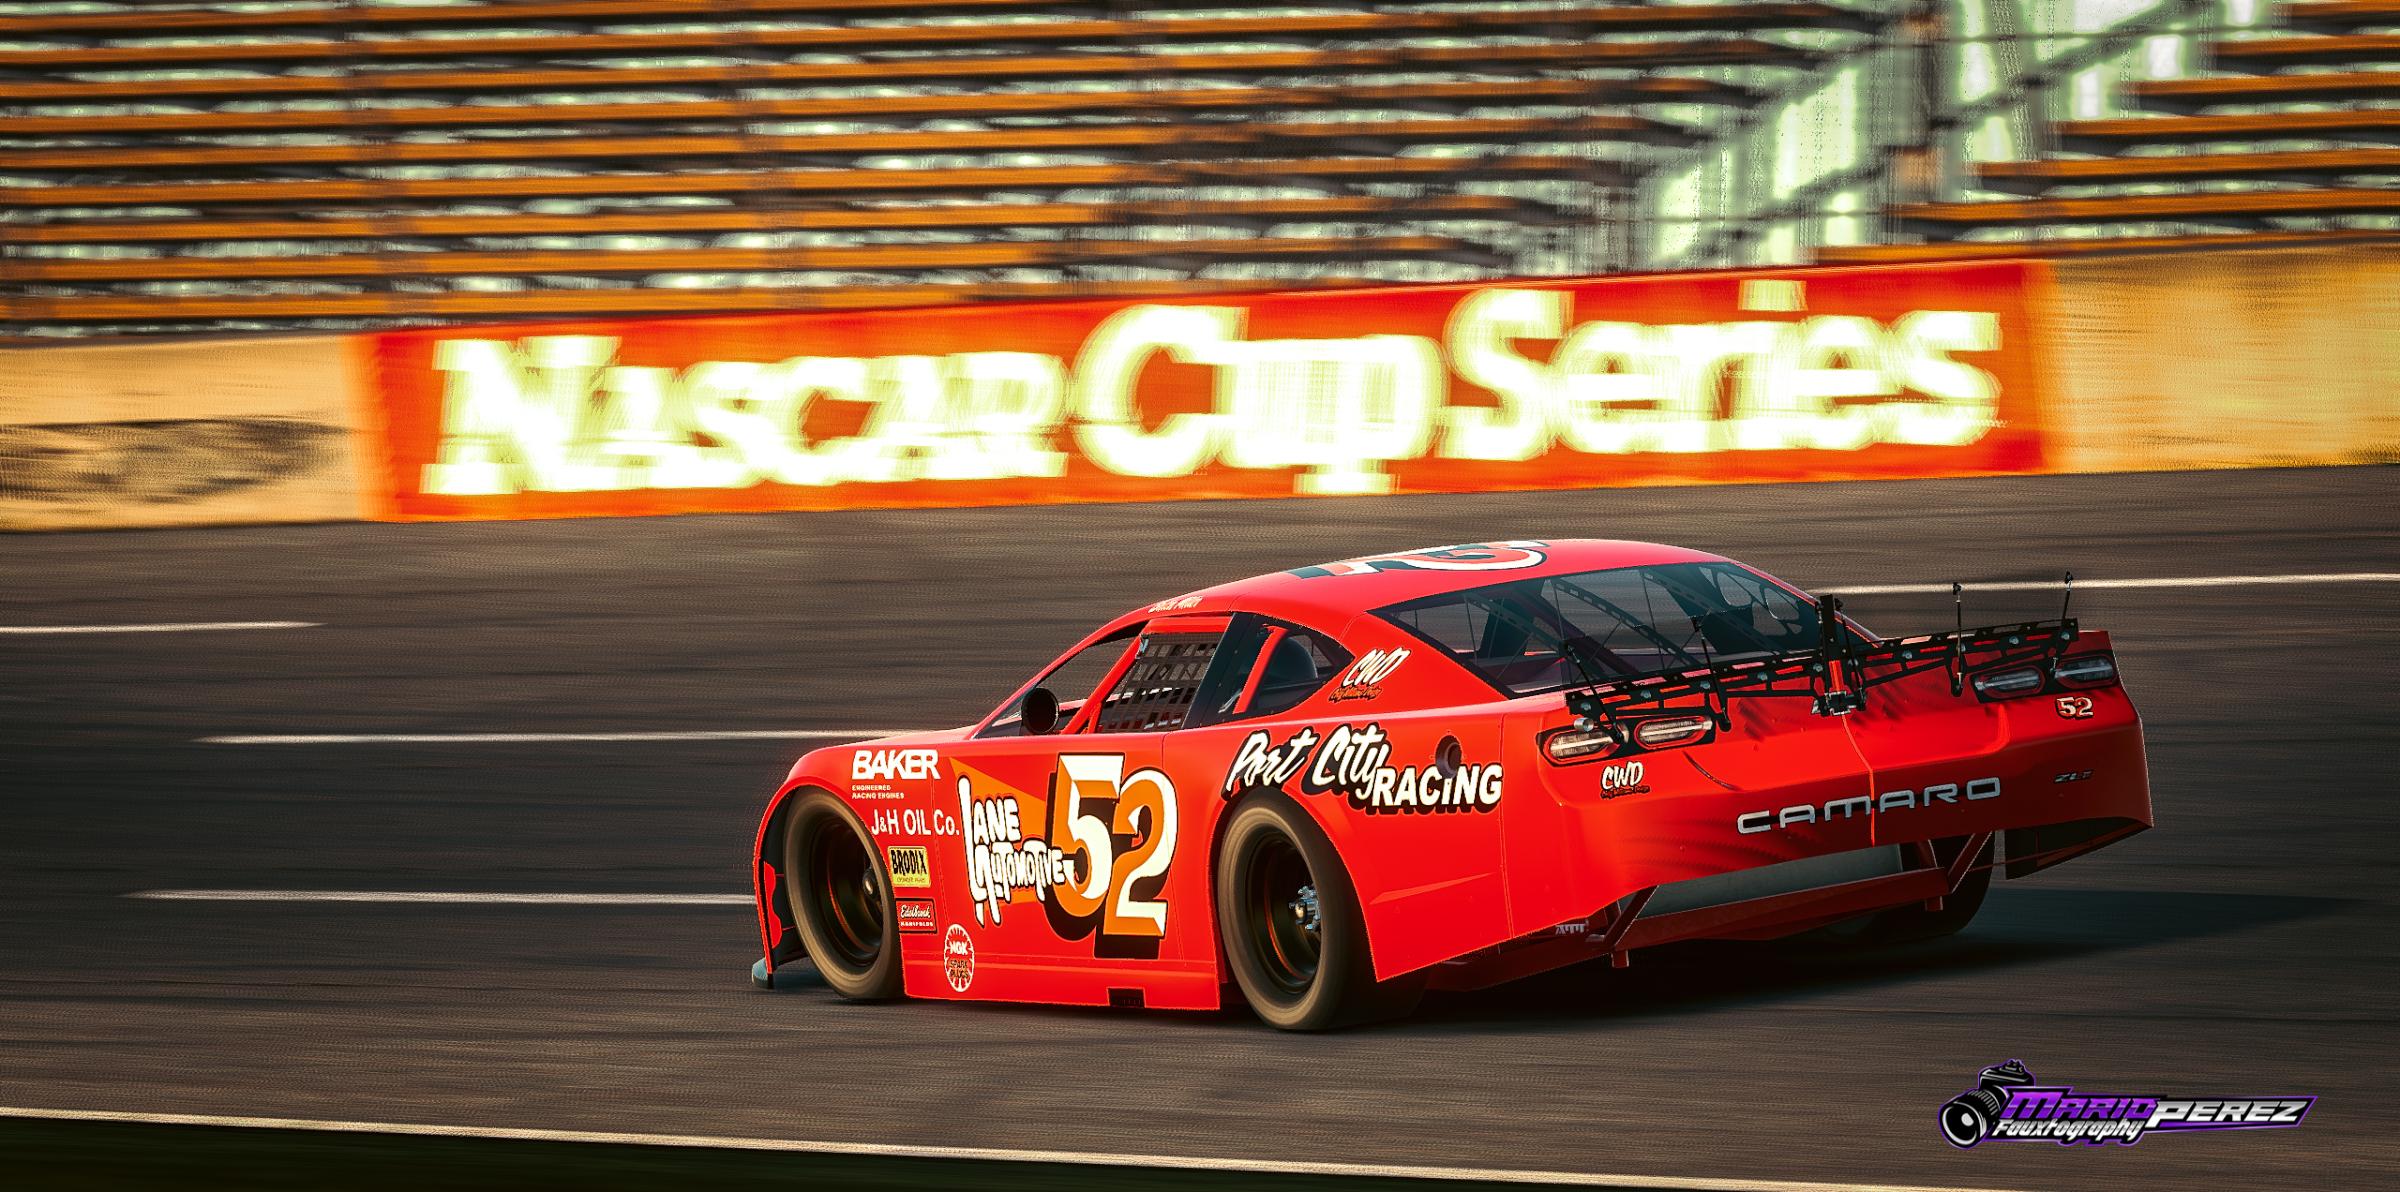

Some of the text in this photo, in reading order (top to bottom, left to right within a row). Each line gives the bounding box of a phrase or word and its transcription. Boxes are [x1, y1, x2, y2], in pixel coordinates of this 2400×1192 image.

[1072, 303, 1445, 495] Cup
[1438, 279, 2002, 462] Series
[1342, 647, 1411, 687] CWD
[2056, 696, 2094, 718] 52
[851, 749, 941, 780] BAKER
[1224, 725, 1391, 800] Port City
[1601, 761, 1644, 790] CWD
[1371, 763, 1503, 807] RACING
[871, 808, 900, 836] J&H
[903, 808, 932, 836] OIL
[1737, 777, 2001, 834] CAMARO
[891, 850, 927, 875] BRODIX
[1043, 752, 1180, 960] 52
[950, 941, 968, 955] NGK
